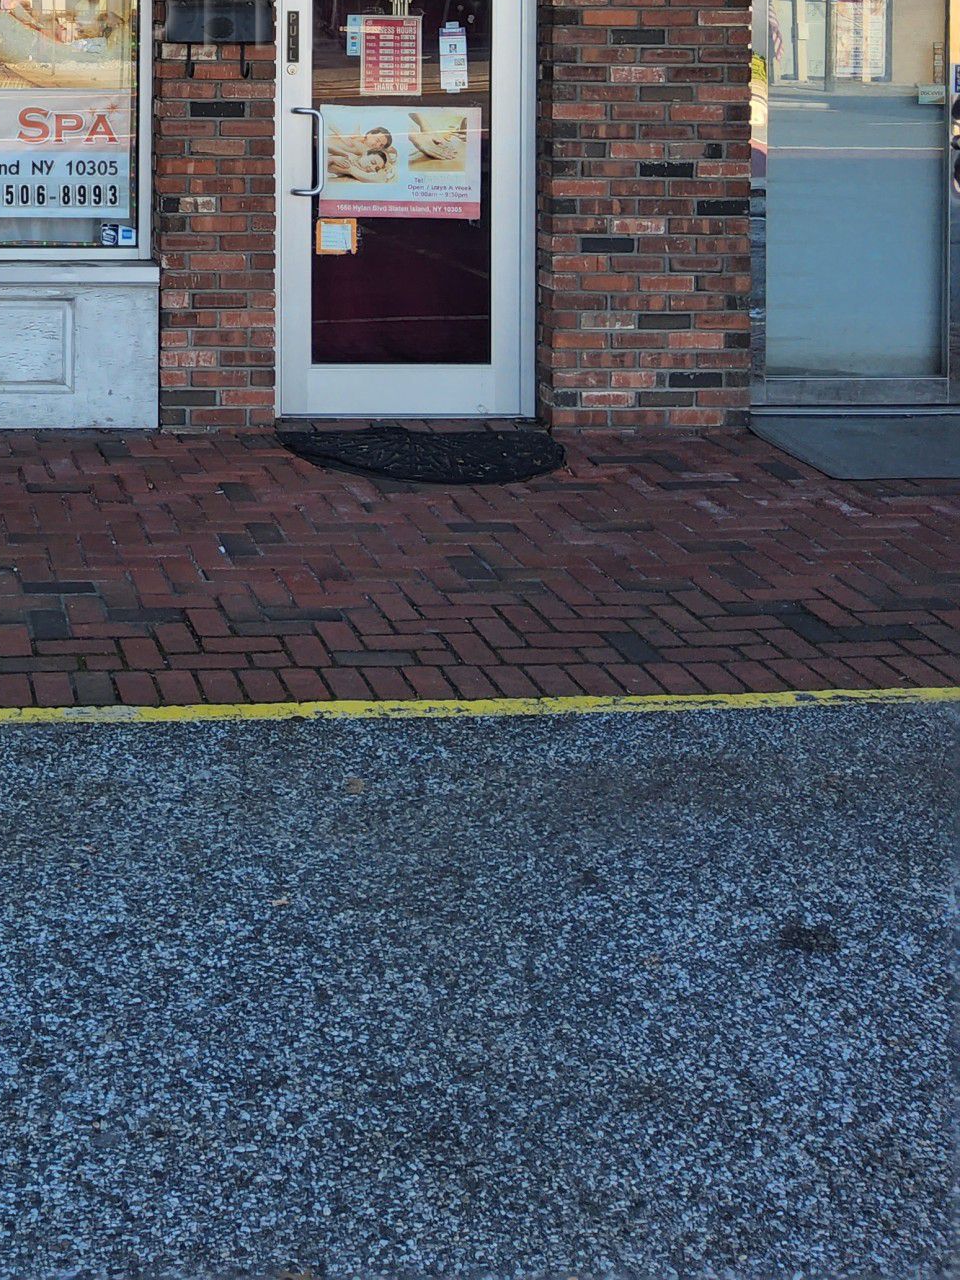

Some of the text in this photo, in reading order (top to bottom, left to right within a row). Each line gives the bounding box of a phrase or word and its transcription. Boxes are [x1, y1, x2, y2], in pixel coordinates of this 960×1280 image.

[373, 82, 409, 91] THANK YOU
[17, 105, 119, 143] SPA
[31, 160, 55, 176] NY
[65, 160, 119, 176] 10305
[352, 204, 371, 212] Hylan
